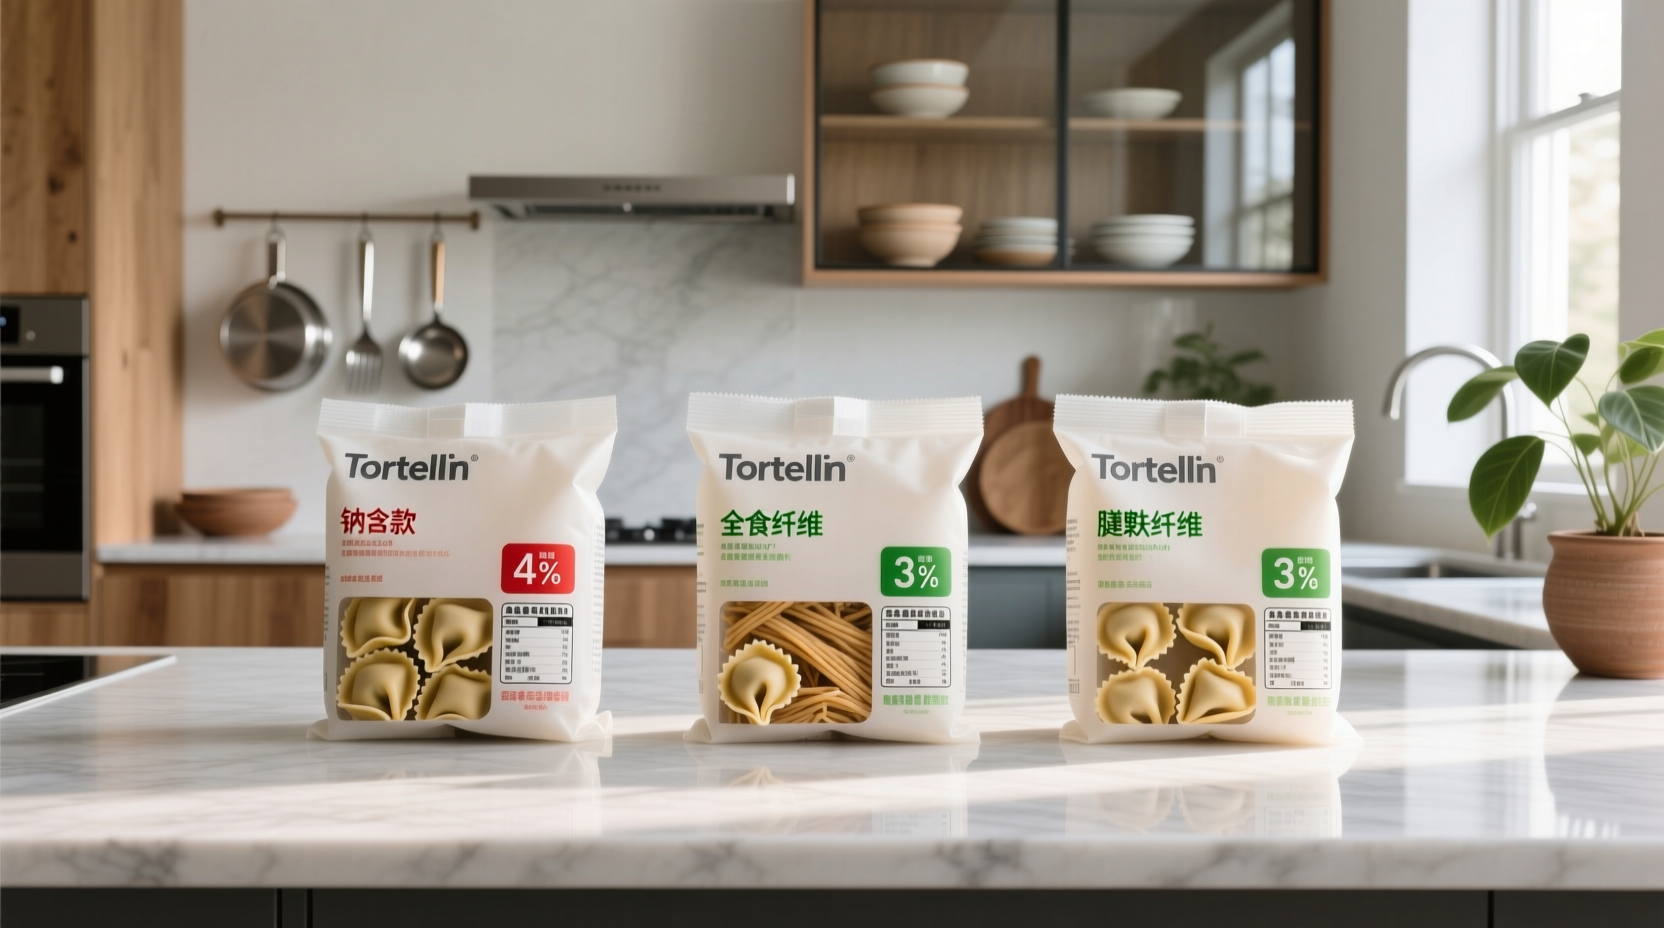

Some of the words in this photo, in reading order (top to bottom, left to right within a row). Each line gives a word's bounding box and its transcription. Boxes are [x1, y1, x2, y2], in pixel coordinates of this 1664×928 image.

[340, 507, 417, 535] 钠含款
[720, 509, 823, 538] 全食纤维
[513, 552, 561, 585] 4%
[894, 556, 939, 589] 3%
[1274, 557, 1319, 590] 3%
